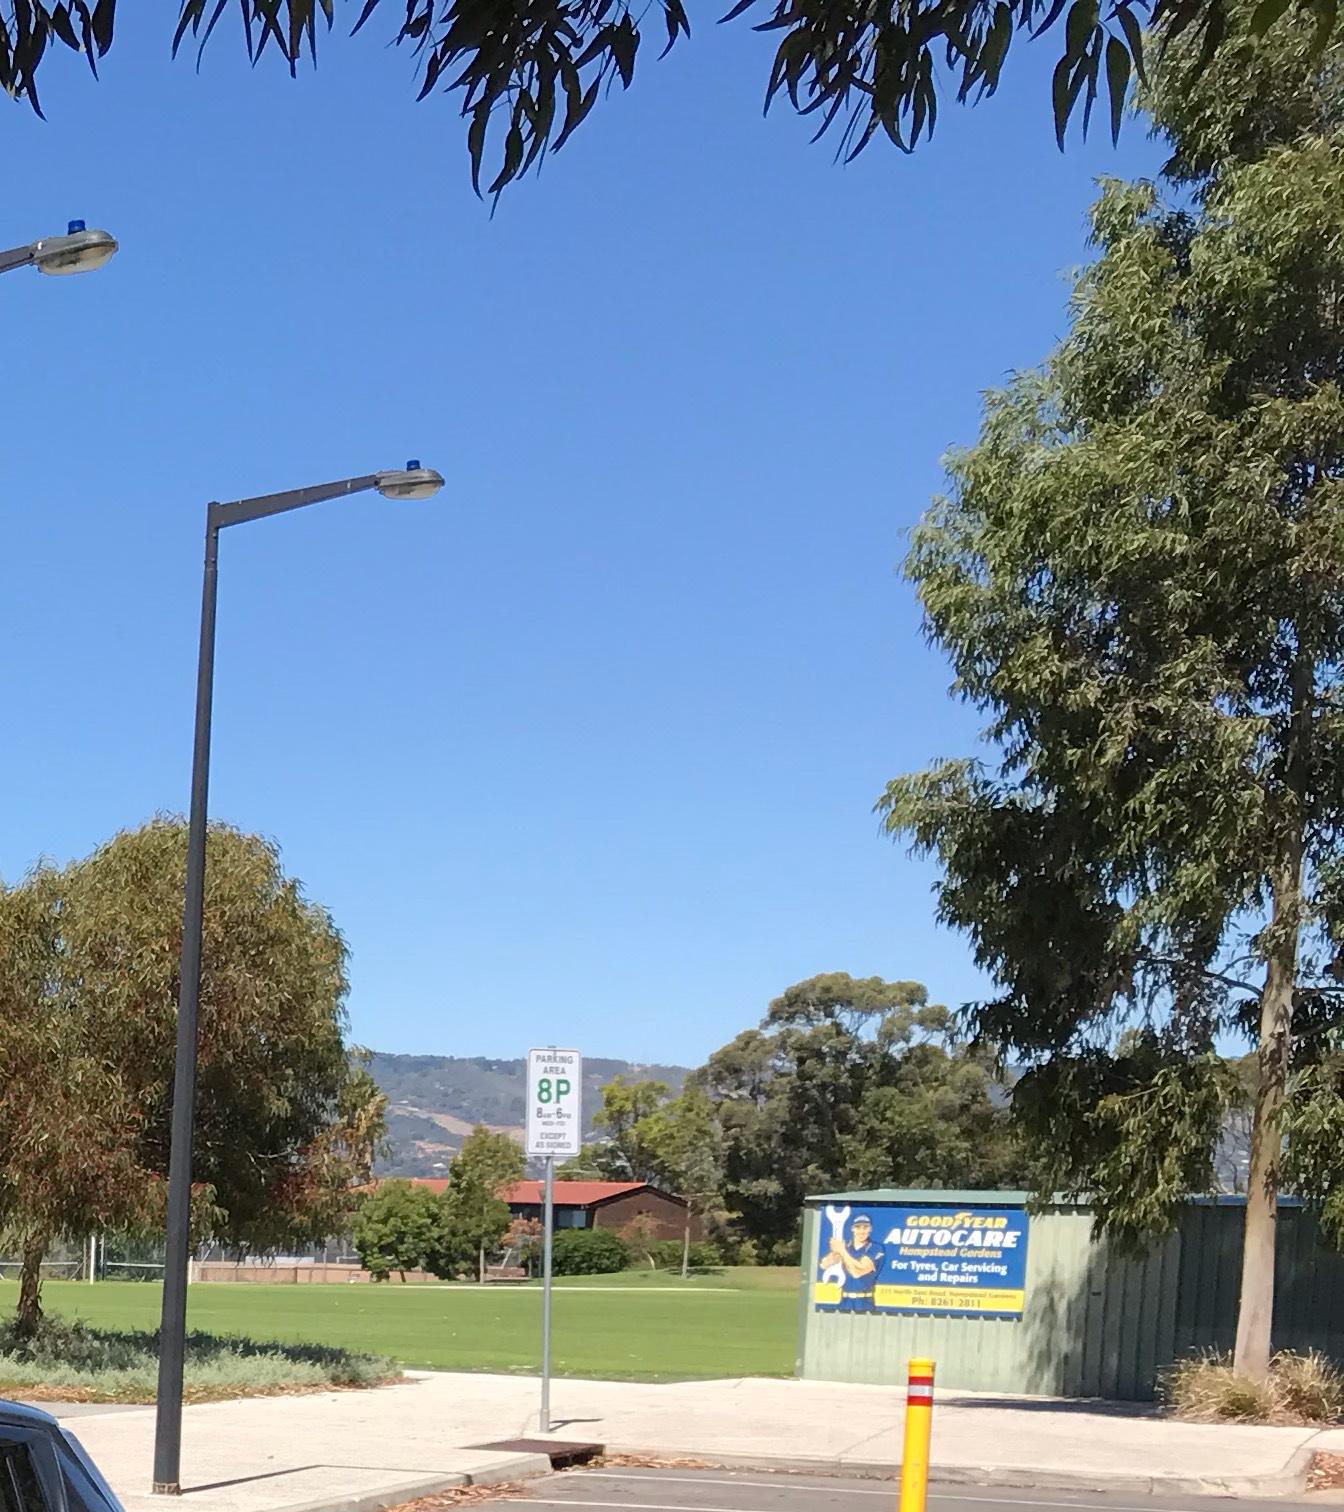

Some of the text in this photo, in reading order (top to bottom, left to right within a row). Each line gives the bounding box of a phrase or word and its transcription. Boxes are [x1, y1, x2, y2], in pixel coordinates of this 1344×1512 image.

[535, 1054, 574, 1064] PARKING
[543, 1066, 566, 1075] AREA
[537, 1078, 571, 1104] 8P
[884, 1228, 1022, 1248] AUTOCARE
[899, 1247, 1002, 1259] Hampstead Gardens
[891, 1260, 1008, 1276] For Tyres, Car Servicing
[917, 1273, 978, 1284] and Repairs
[912, 1297, 927, 1306] Ph:
